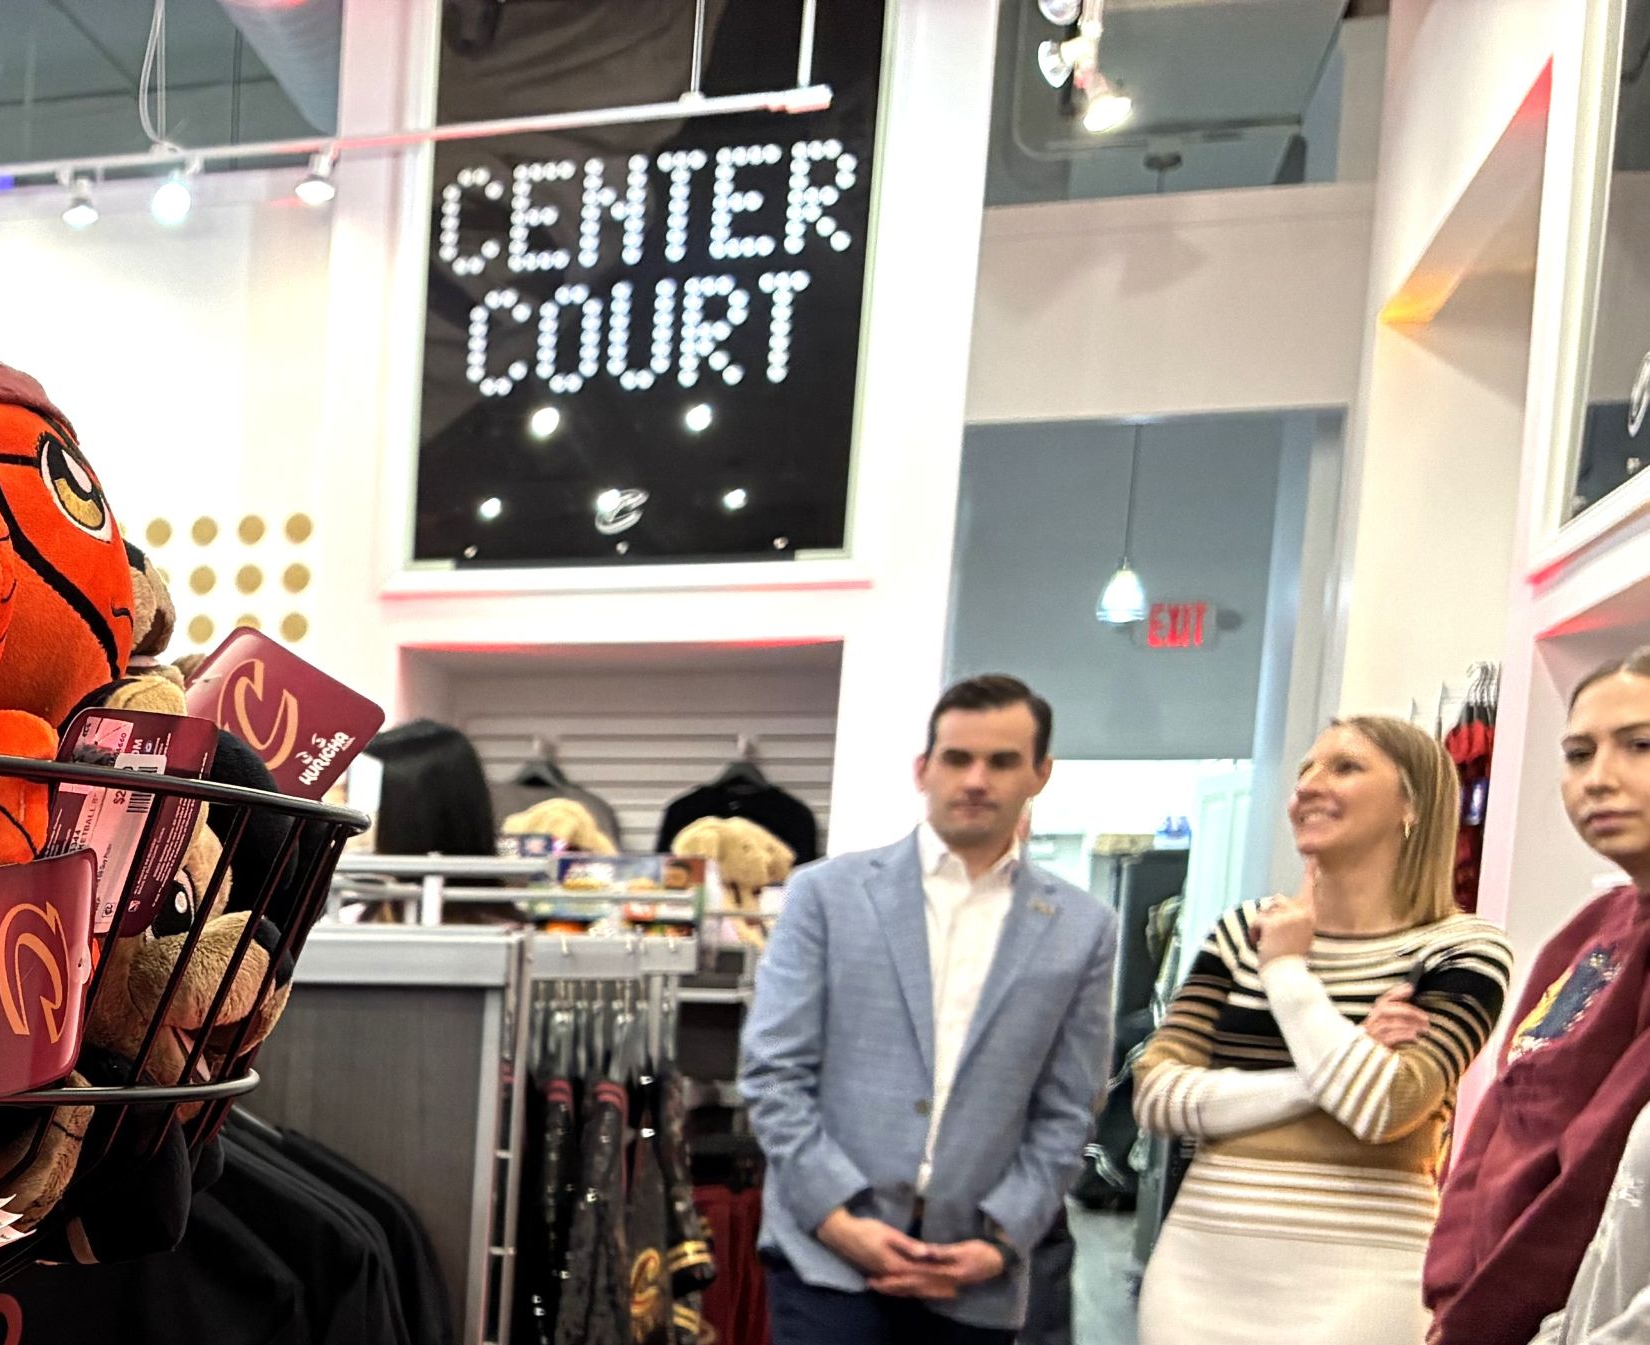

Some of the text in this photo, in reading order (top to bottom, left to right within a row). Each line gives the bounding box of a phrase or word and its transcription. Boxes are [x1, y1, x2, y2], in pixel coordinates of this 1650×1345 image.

[439, 139, 856, 275] CENTER
[467, 271, 810, 397] COURT
[1147, 603, 1206, 648] EXIT
